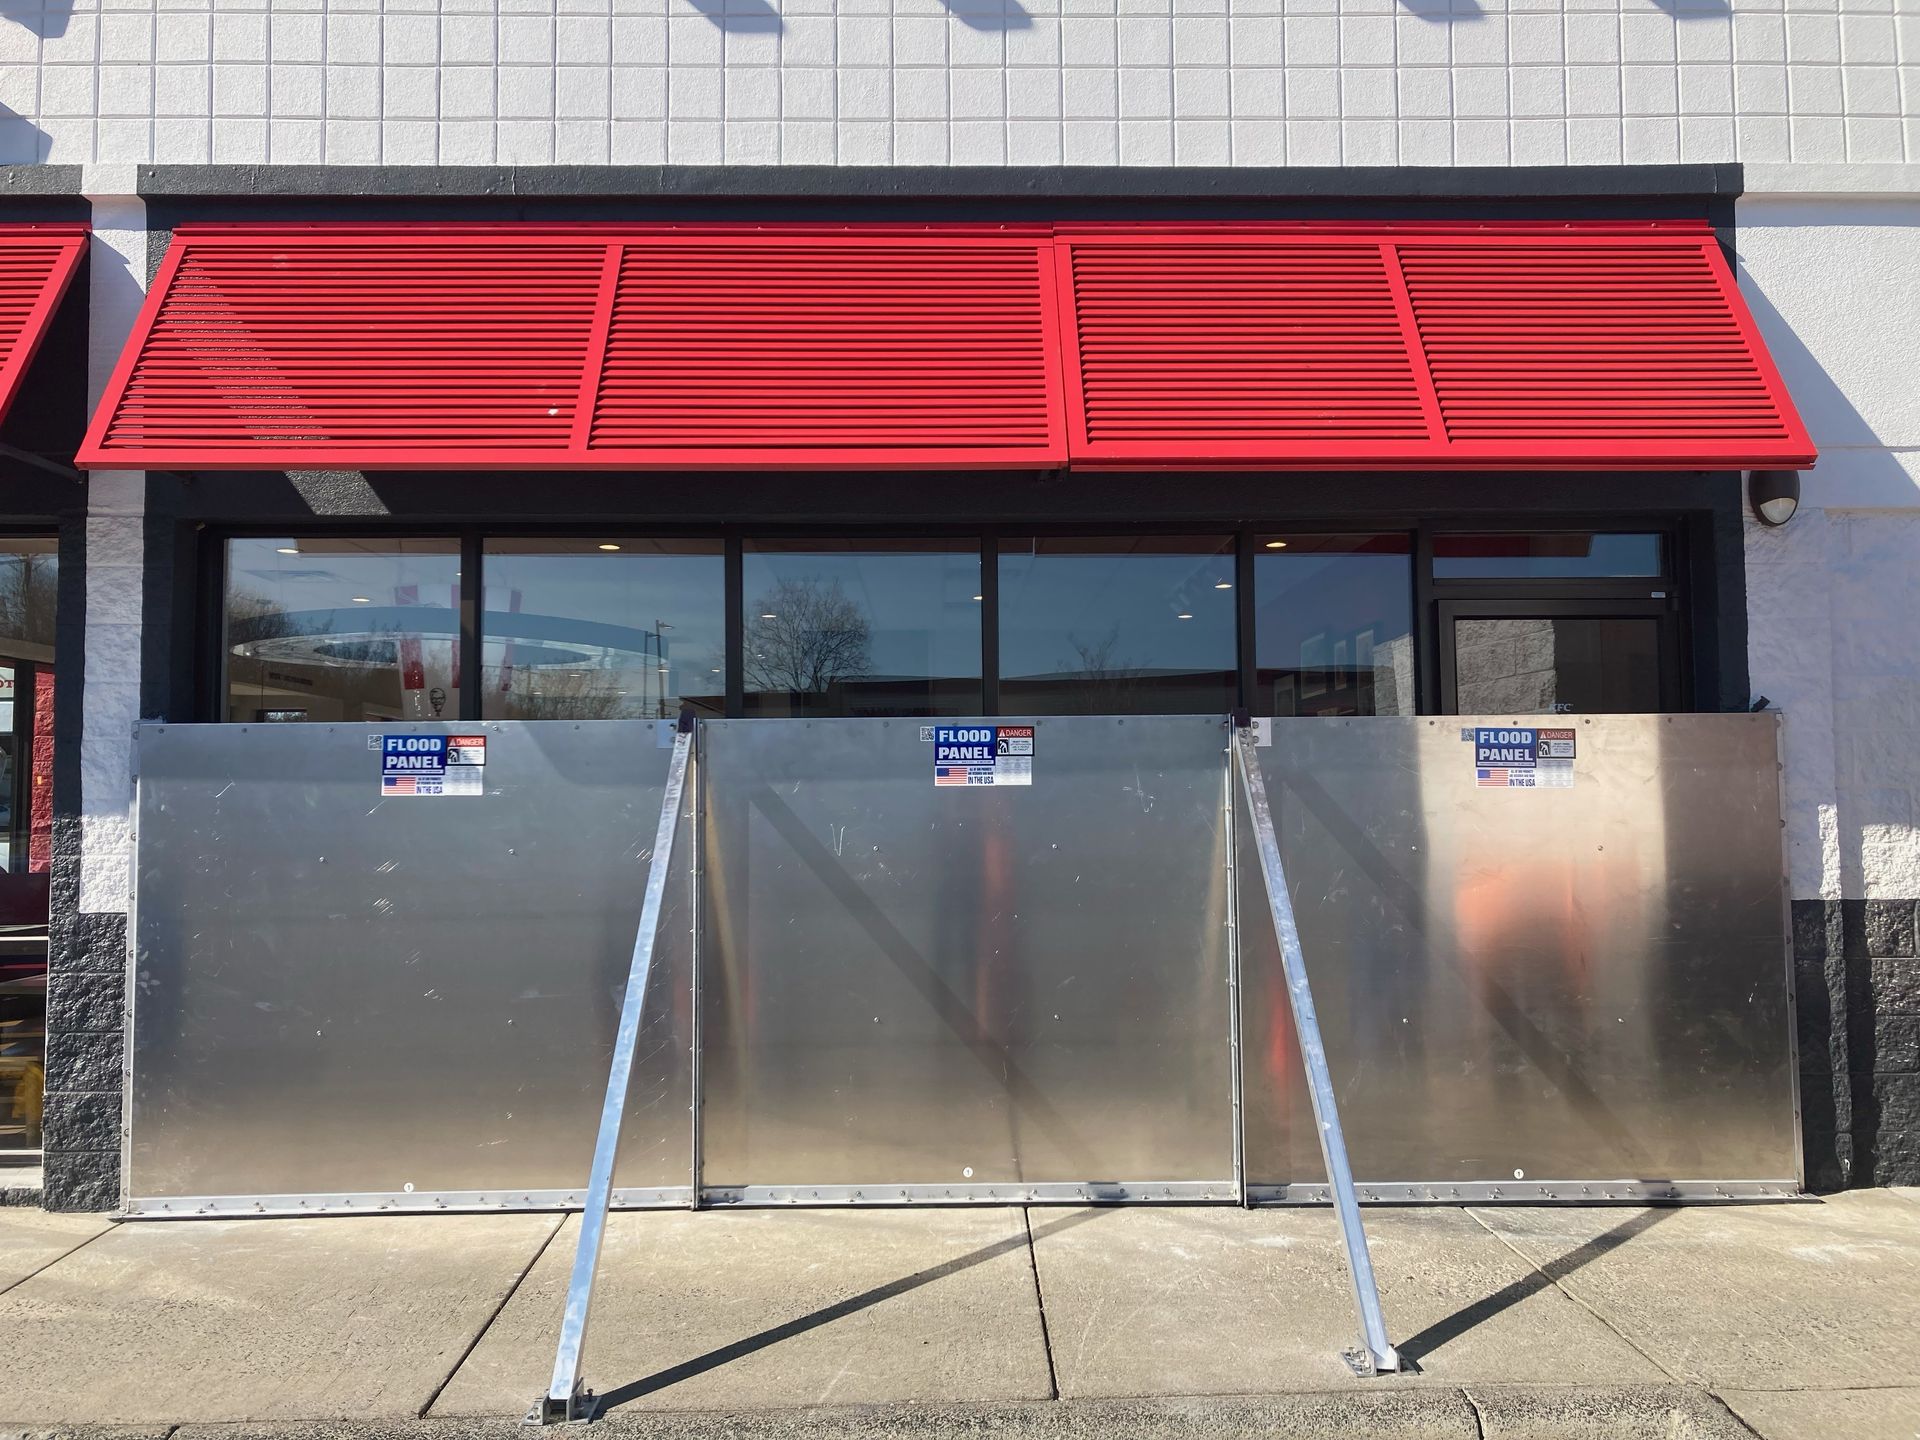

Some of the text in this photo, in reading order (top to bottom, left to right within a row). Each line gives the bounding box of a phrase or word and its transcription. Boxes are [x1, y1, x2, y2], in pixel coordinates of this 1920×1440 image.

[939, 729, 991, 743] FLOOD
[1005, 729, 1032, 737] DANGER
[1479, 731, 1532, 744] FLOOD
[1546, 731, 1573, 739] DANGER
[387, 738, 442, 752] FLOOD
[456, 738, 485, 746] DANGER
[938, 746, 992, 759] PANEL
[1479, 748, 1533, 761] PANEL
[386, 755, 442, 769] PANEL
[968, 776, 994, 785] IN THE USA
[1509, 779, 1536, 787] IN THE USA
